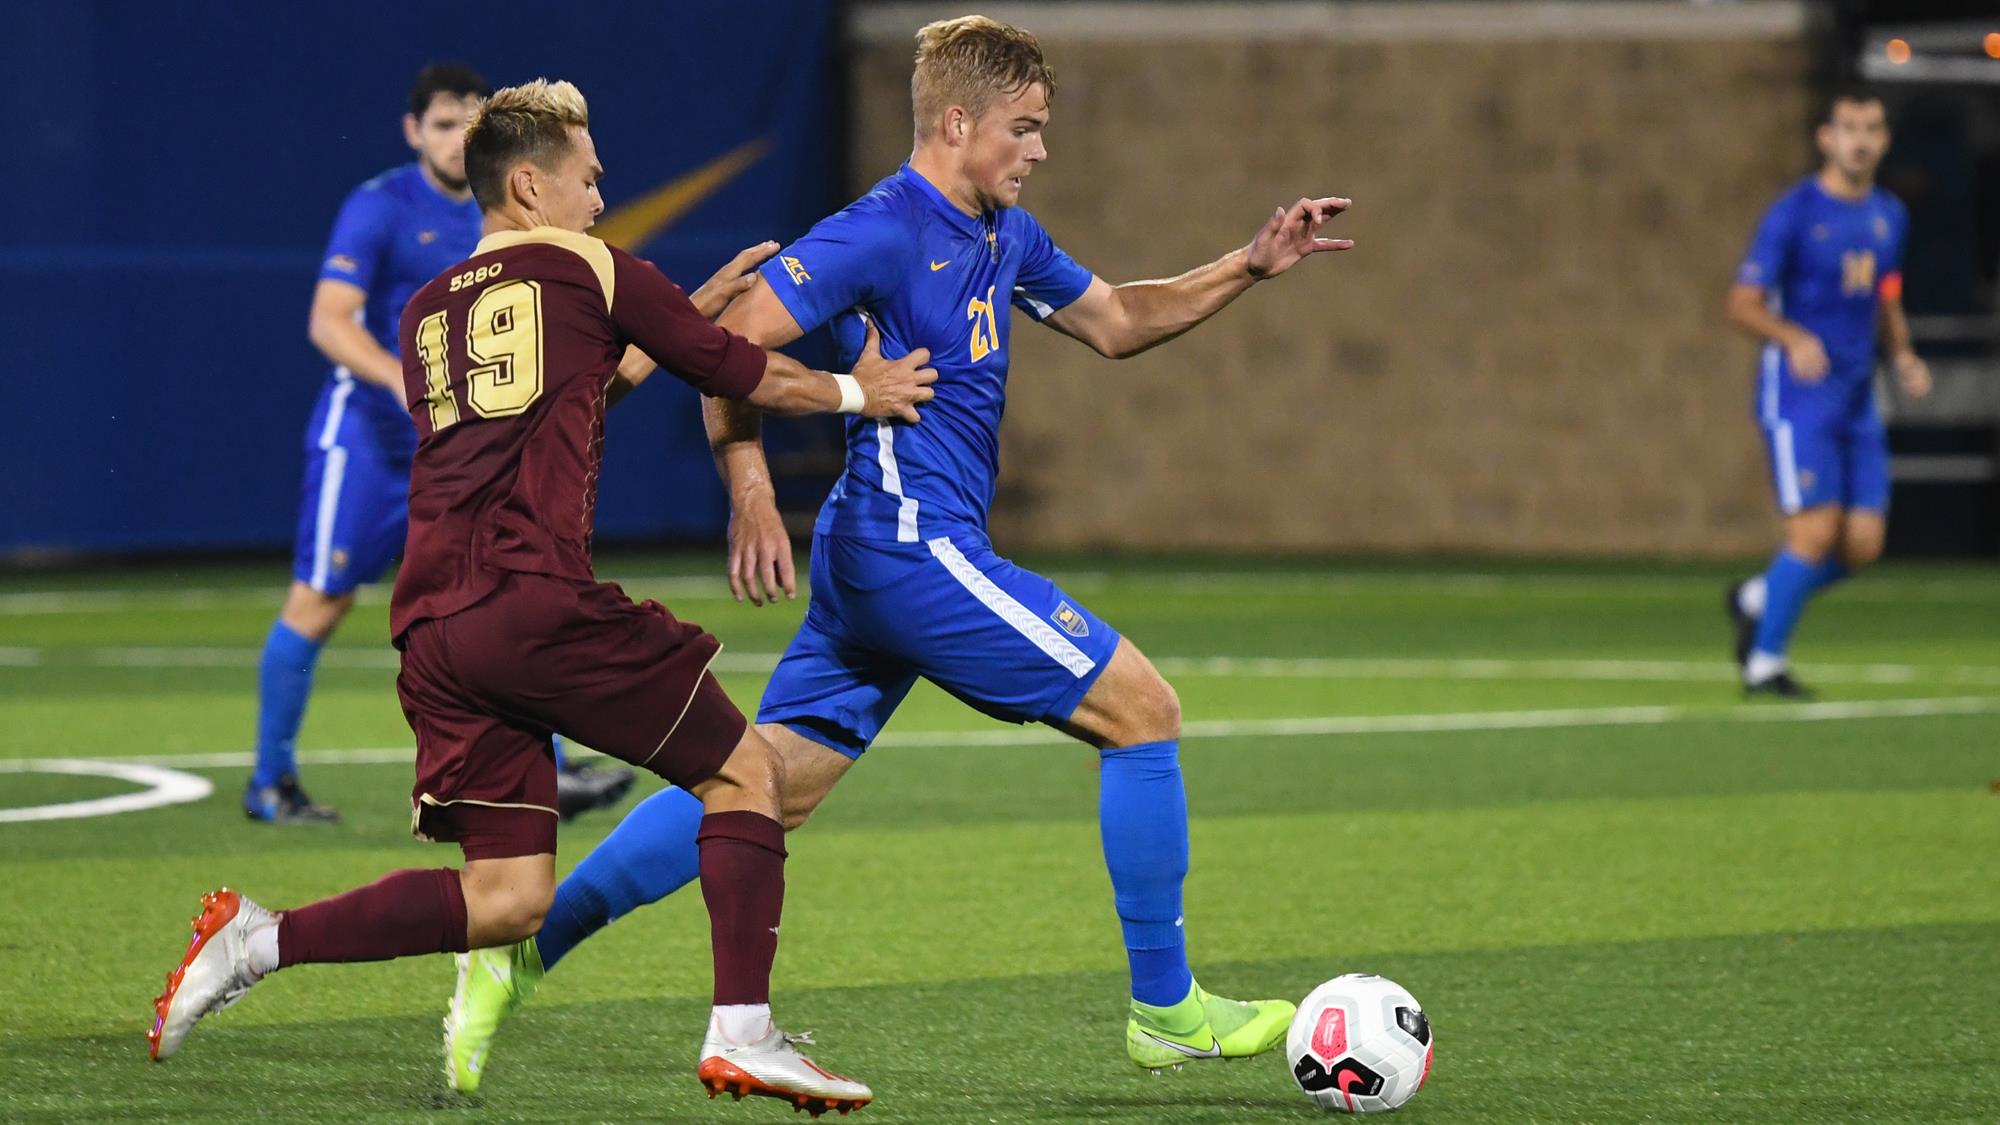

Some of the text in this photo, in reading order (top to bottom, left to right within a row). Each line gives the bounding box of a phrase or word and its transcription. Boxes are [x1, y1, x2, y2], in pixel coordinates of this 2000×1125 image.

[449, 262, 503, 292] 5280
[783, 256, 812, 284] ACC
[967, 285, 999, 363] 21
[416, 279, 544, 432] 19
